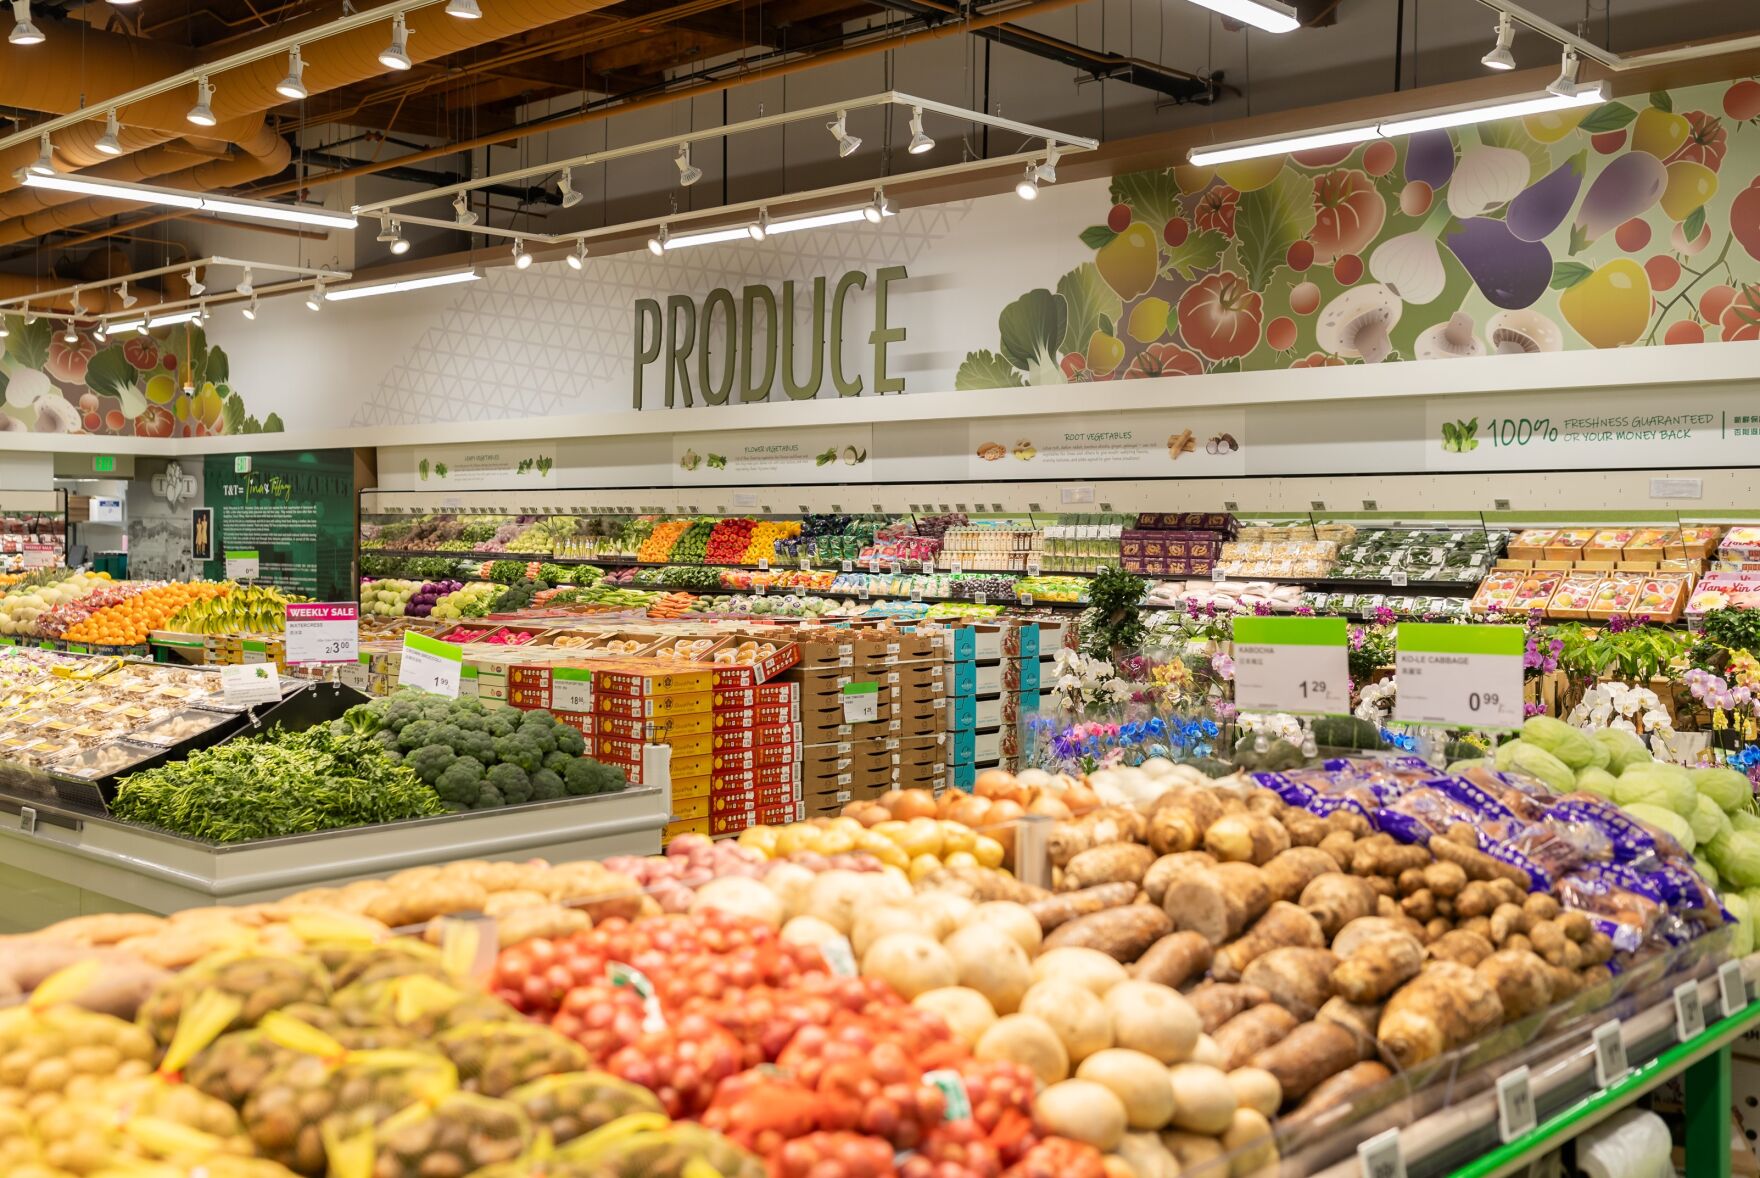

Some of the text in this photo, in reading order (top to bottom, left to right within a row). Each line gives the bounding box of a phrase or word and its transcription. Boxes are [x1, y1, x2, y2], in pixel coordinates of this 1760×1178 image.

[632, 265, 908, 410] PRODUCE
[1487, 413, 1714, 447] 100% FRESHNESS GUARANTEED
[1563, 428, 1691, 442] OR YOUR MONEY BACK
[1064, 431, 1132, 441] ROOT VEGETABLES
[744, 446, 765, 454] FLOWER
[1699, 581, 1727, 593] Tang
[1731, 582, 1750, 593] Xin
[290, 607, 354, 617] WEEKLY SALE
[1239, 646, 1274, 654] KABOCHA
[1401, 656, 1469, 665] KO-LE CABBAGE
